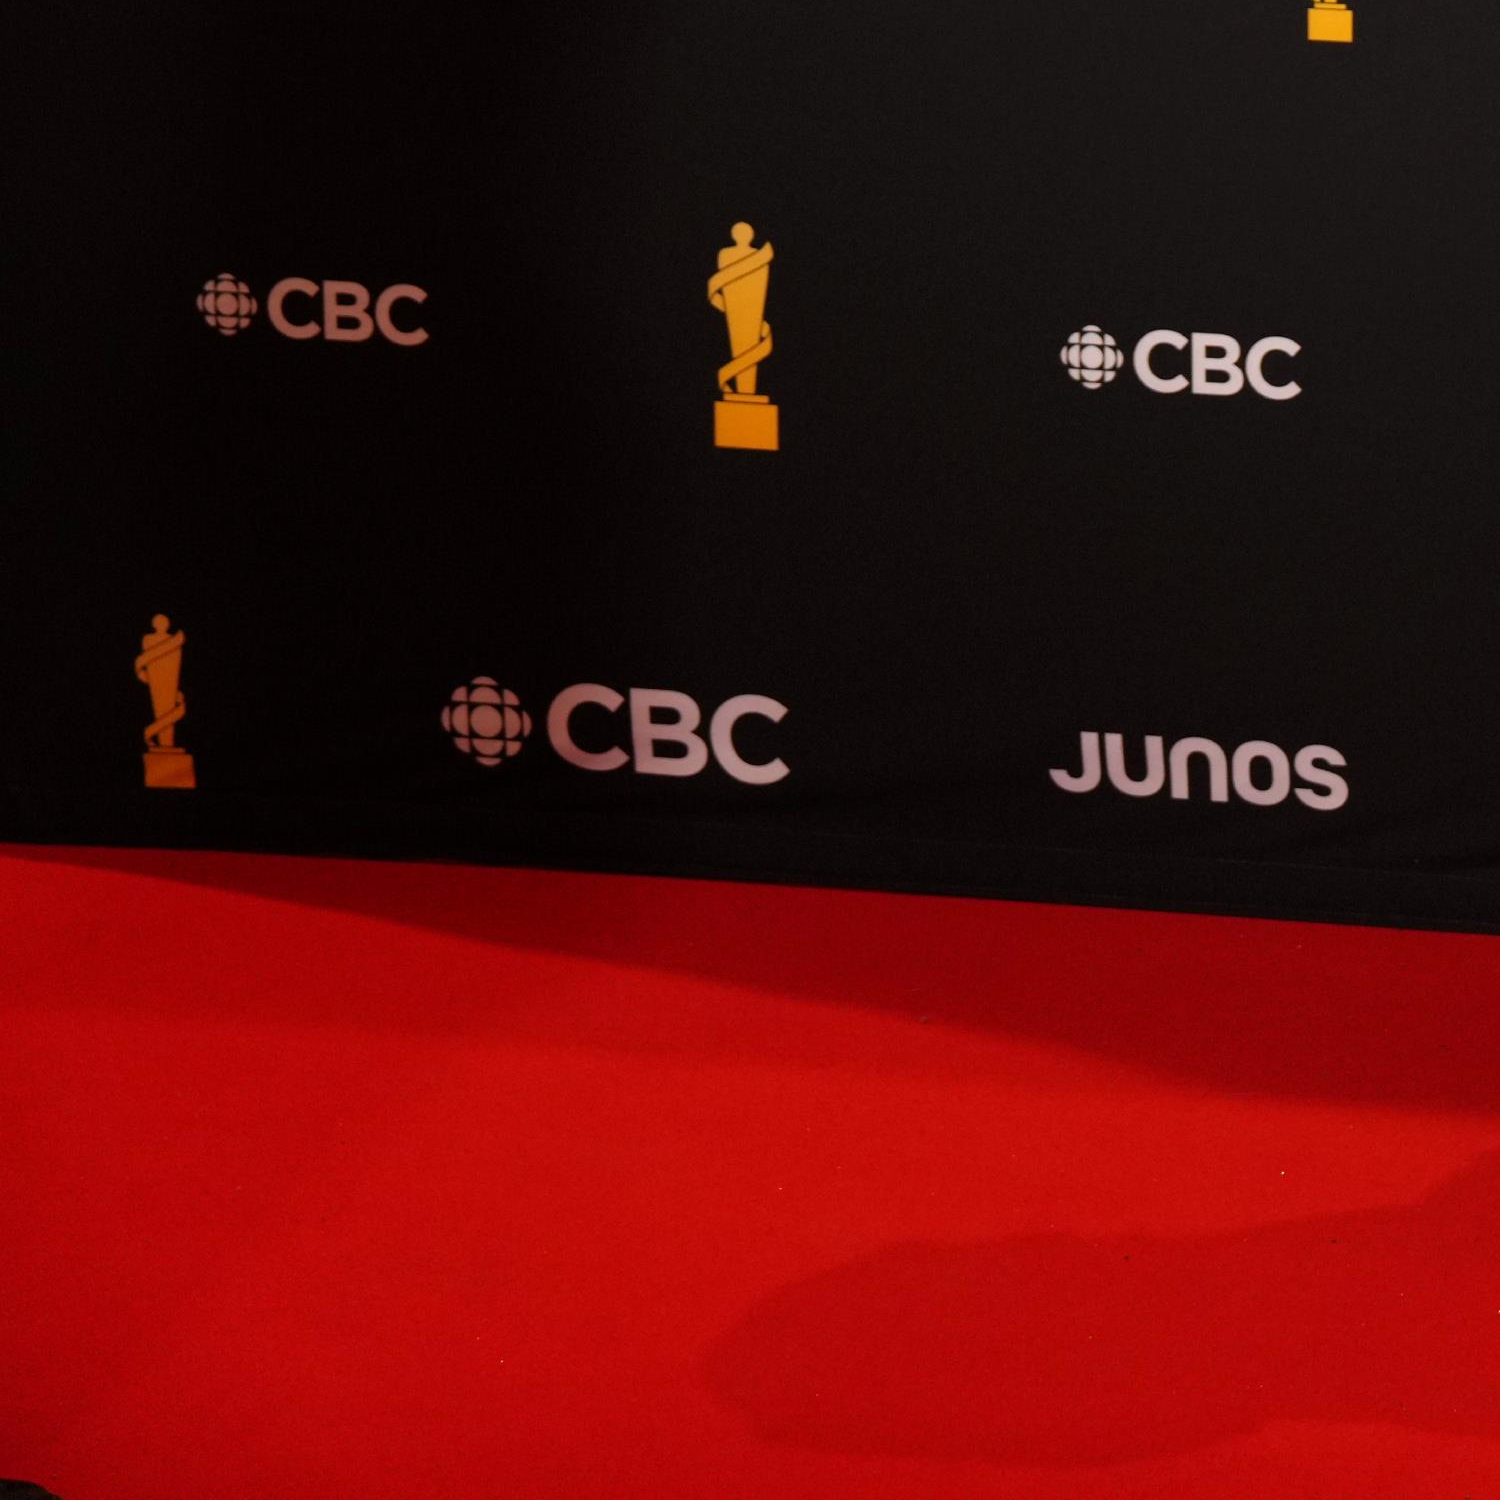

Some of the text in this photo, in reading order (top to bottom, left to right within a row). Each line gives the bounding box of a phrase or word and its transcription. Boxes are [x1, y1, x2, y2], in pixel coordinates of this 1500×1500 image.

[267, 277, 429, 346] CBC
[1133, 329, 1302, 401] CBC
[547, 683, 790, 785] CBC
[1049, 731, 1349, 811] JUNOS
